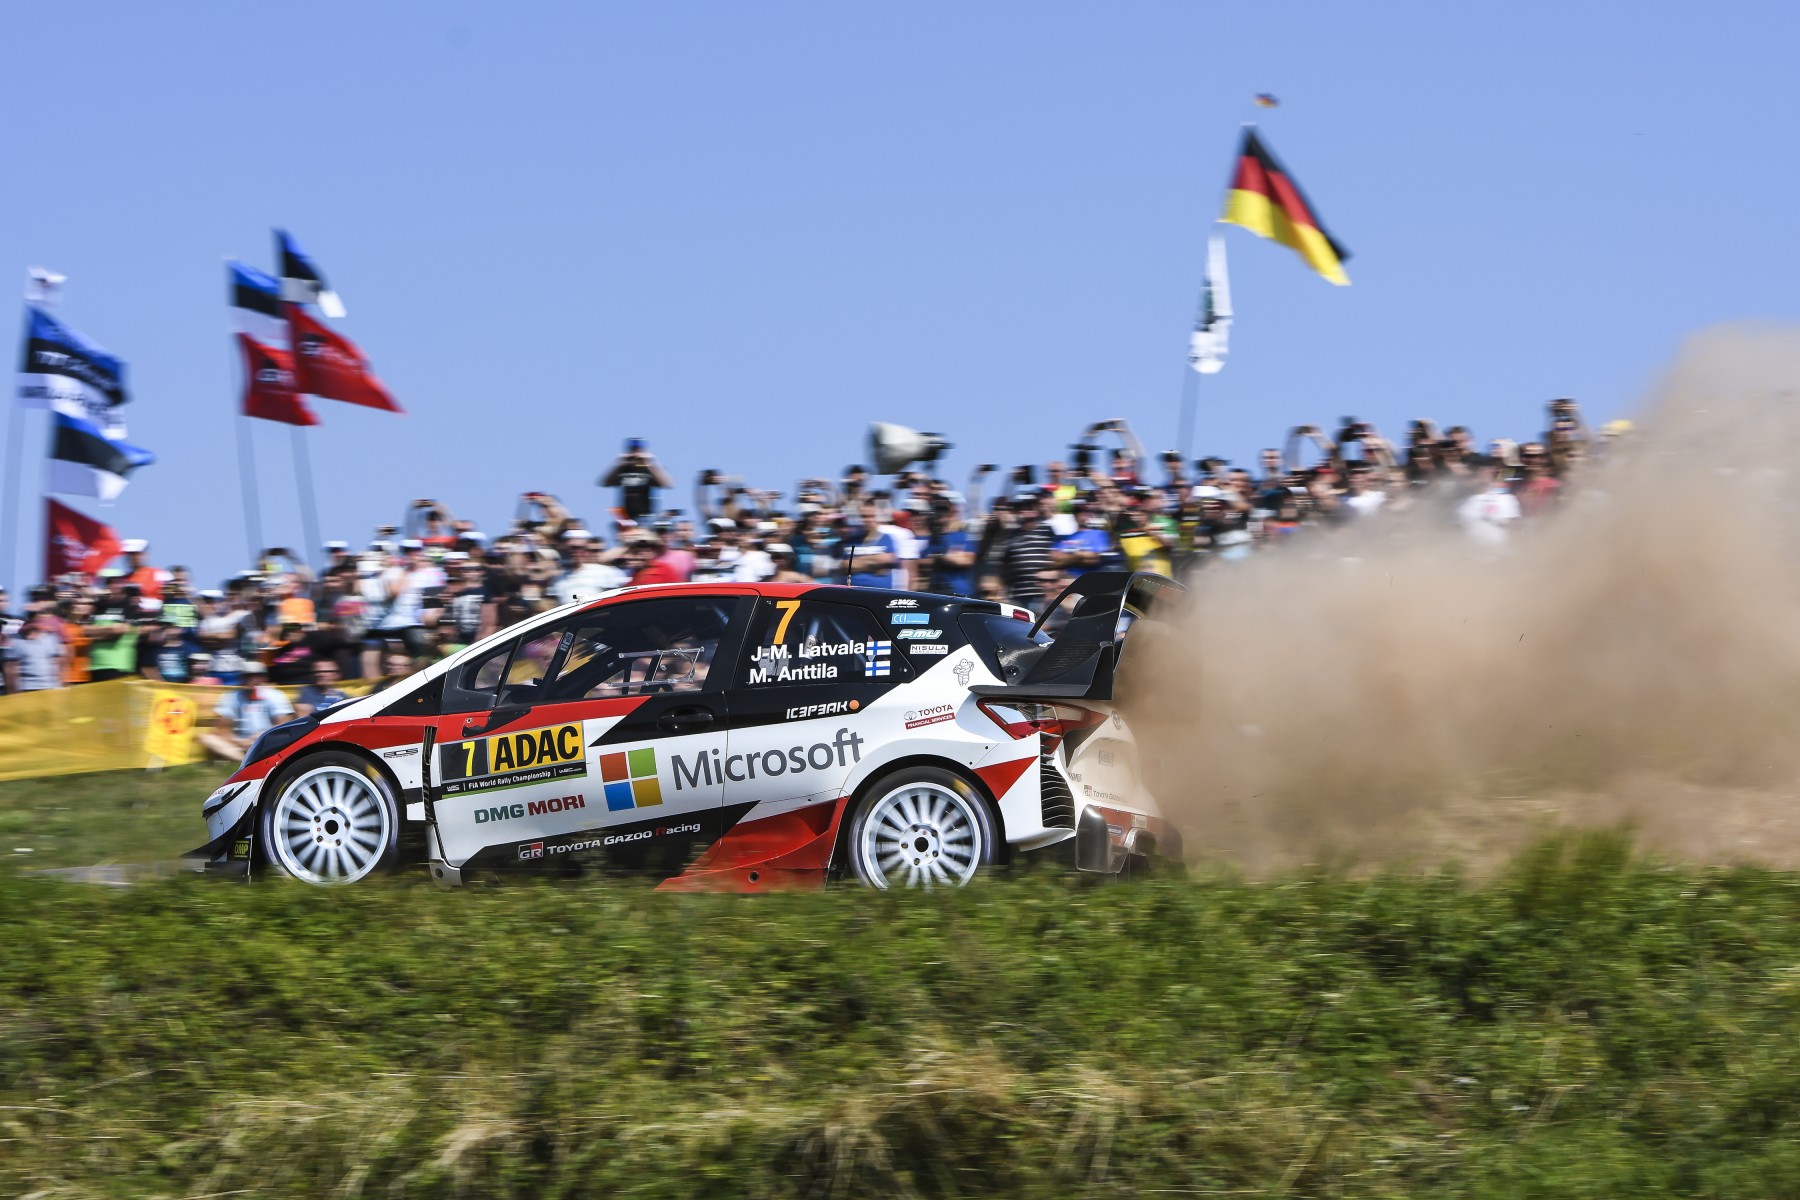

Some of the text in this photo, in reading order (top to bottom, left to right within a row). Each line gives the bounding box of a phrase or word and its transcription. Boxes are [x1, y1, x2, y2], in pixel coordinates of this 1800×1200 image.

[773, 600, 800, 644] 7
[751, 640, 865, 662] J-M. Latvala
[750, 664, 838, 684] M. Anttila
[918, 704, 953, 716] TOYOTA
[462, 726, 579, 776] 7 ADAC
[671, 727, 864, 790] Microsoft
[469, 781, 478, 790] FIA
[479, 778, 497, 788] World
[497, 776, 511, 787] Rally
[512, 770, 551, 783] Championship
[474, 794, 585, 824] DMG MORI
[547, 839, 600, 854] TOYOTA
[604, 830, 652, 845] GAZOO
[655, 823, 701, 837] Racing
